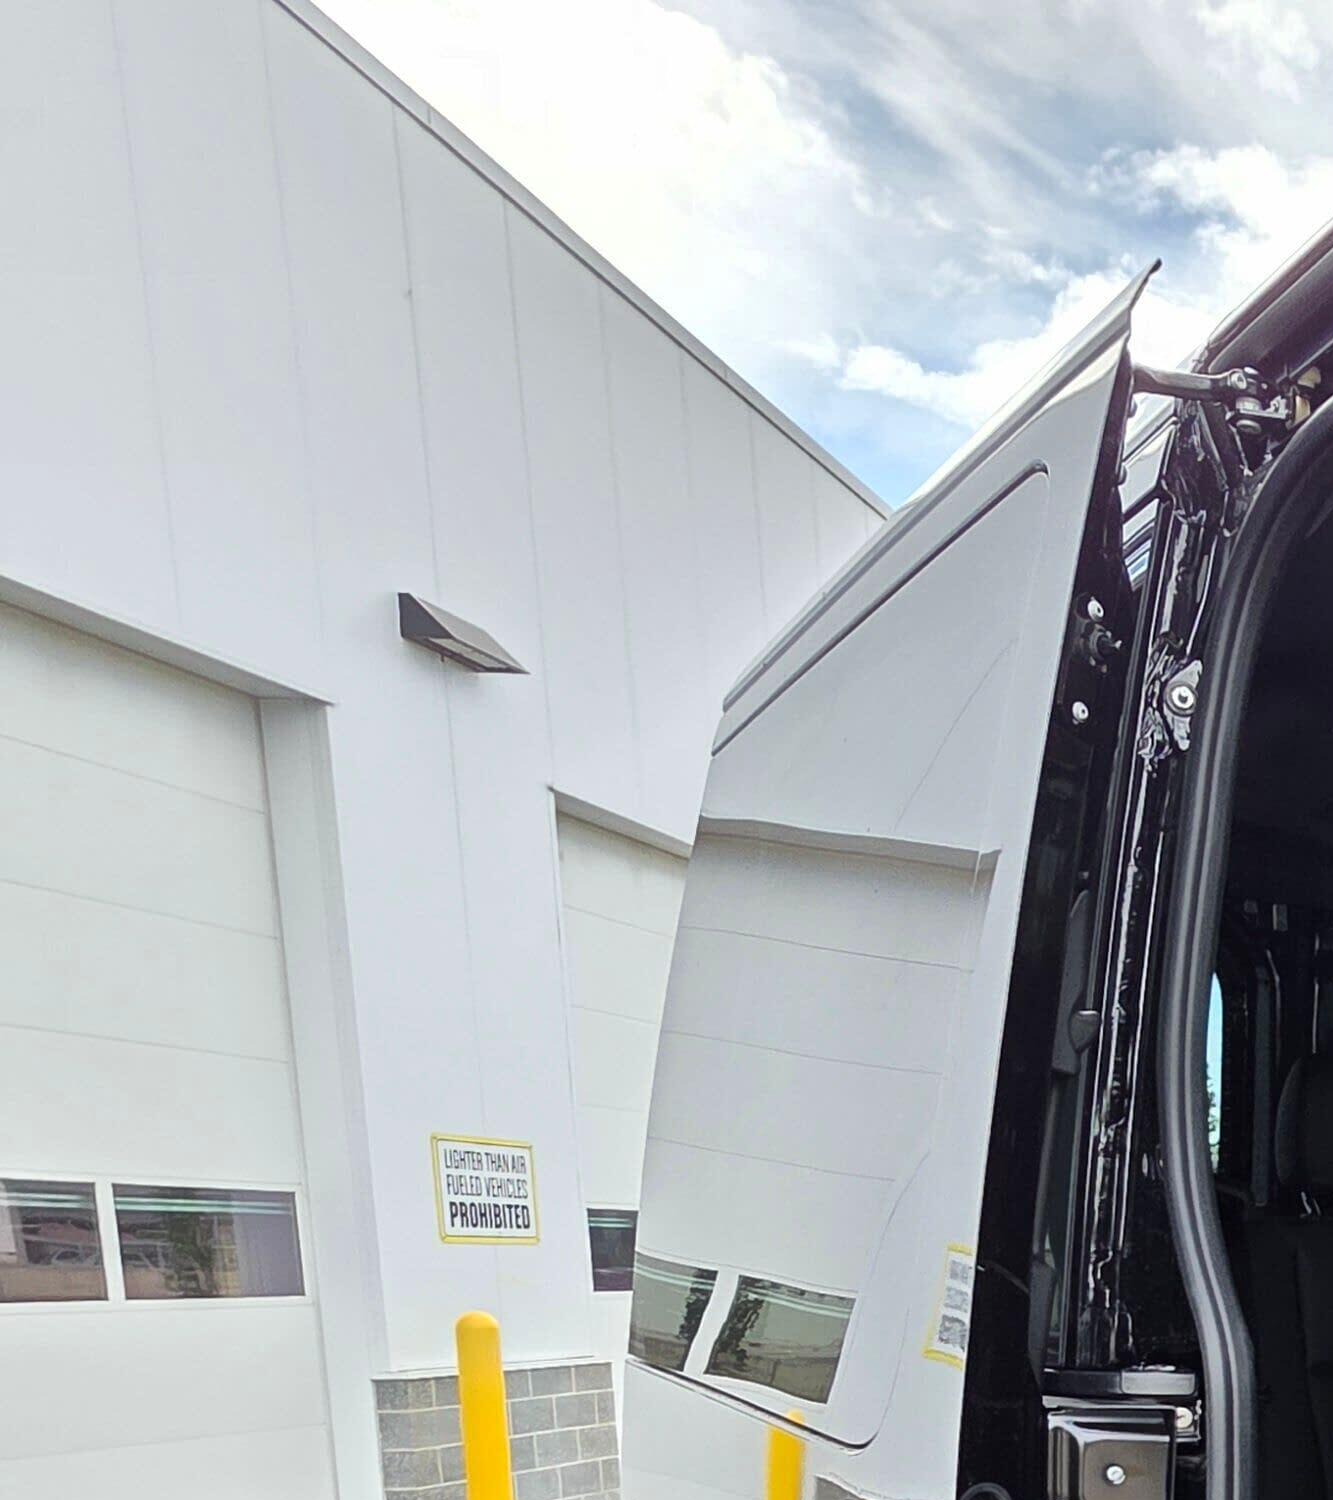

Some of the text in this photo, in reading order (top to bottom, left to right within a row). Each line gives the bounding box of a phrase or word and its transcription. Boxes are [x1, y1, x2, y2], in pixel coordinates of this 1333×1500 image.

[444, 1148, 527, 1174] LIGHTER THAN AIR
[446, 1174, 529, 1199] FUELED VEHICLES
[449, 1201, 531, 1229] PROHIBITED
